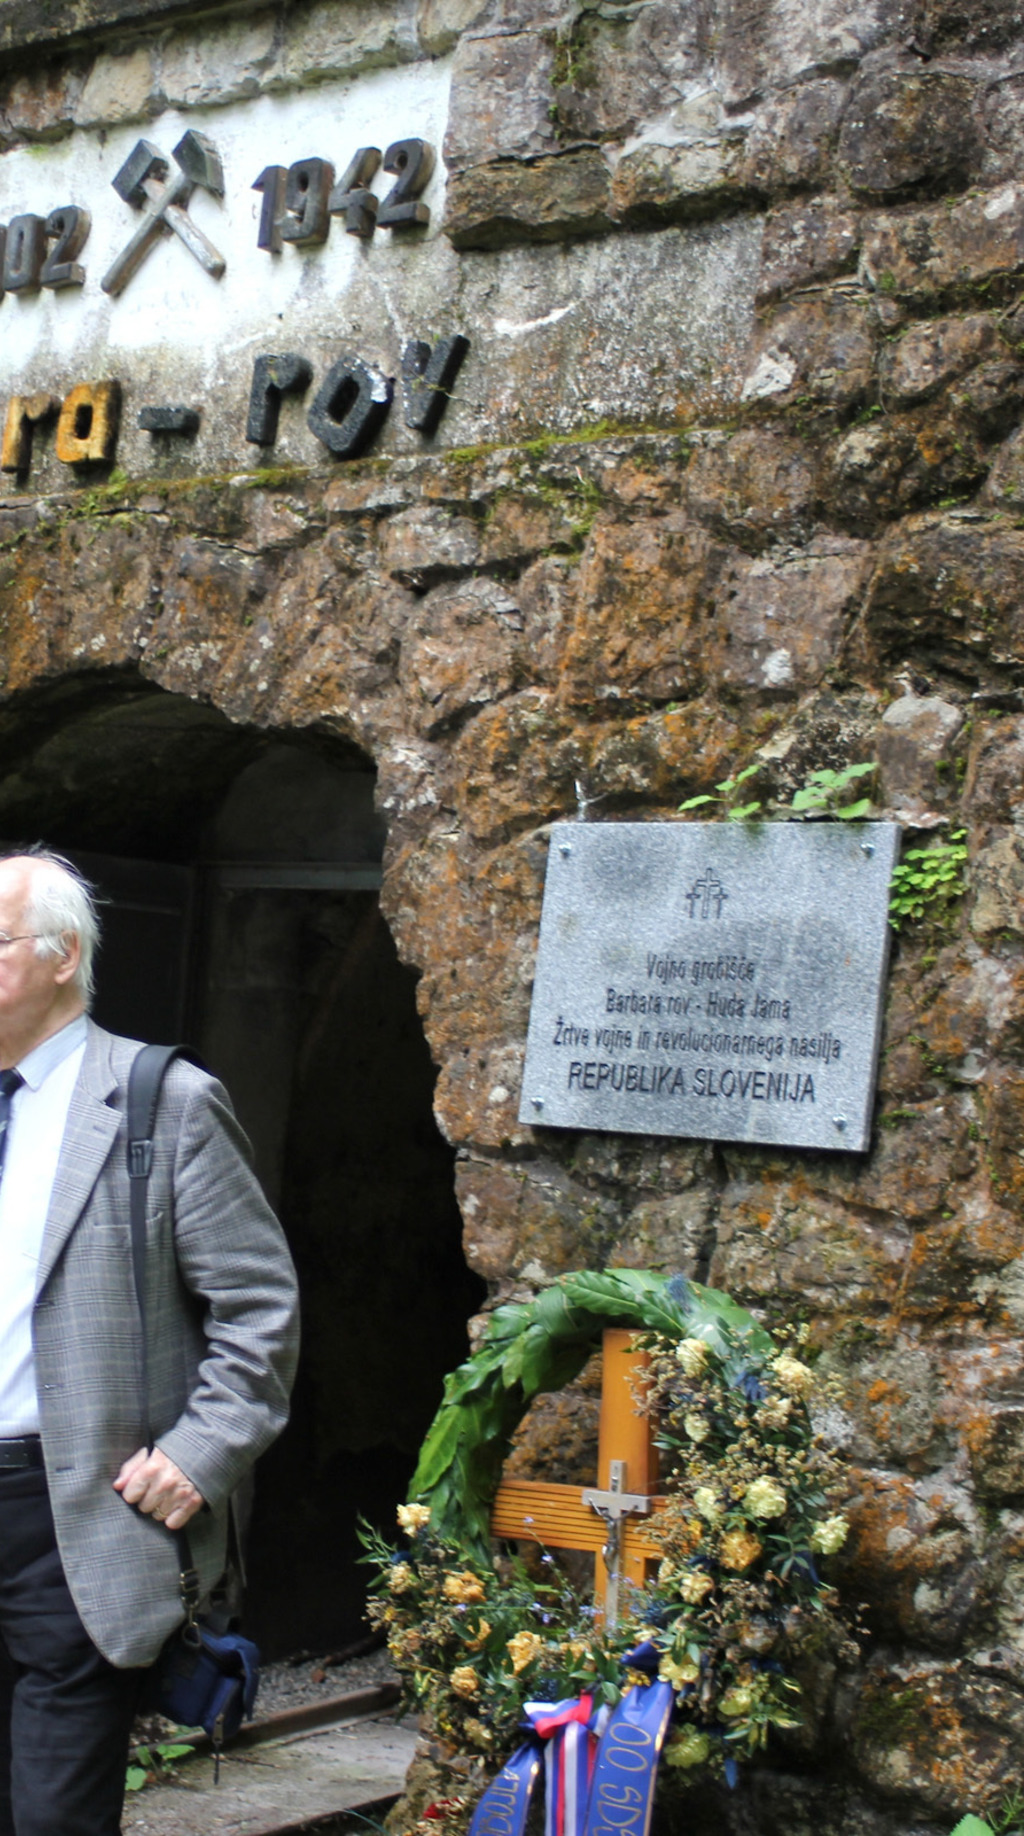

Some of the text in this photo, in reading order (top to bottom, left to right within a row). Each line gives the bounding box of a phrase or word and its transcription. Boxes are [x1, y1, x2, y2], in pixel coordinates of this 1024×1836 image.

[251, 136, 437, 254] 1942
[646, 953, 687, 985] Vojno
[605, 987, 662, 1015] Barbara
[667, 995, 691, 1016] rov
[706, 991, 746, 1018] Huda
[750, 993, 792, 1020] Jama
[553, 1015, 842, 1065] Žrtve vojne in revolucionarnega nasilja
[568, 1061, 816, 1104] REPUBLIKA SLOVENIJA
